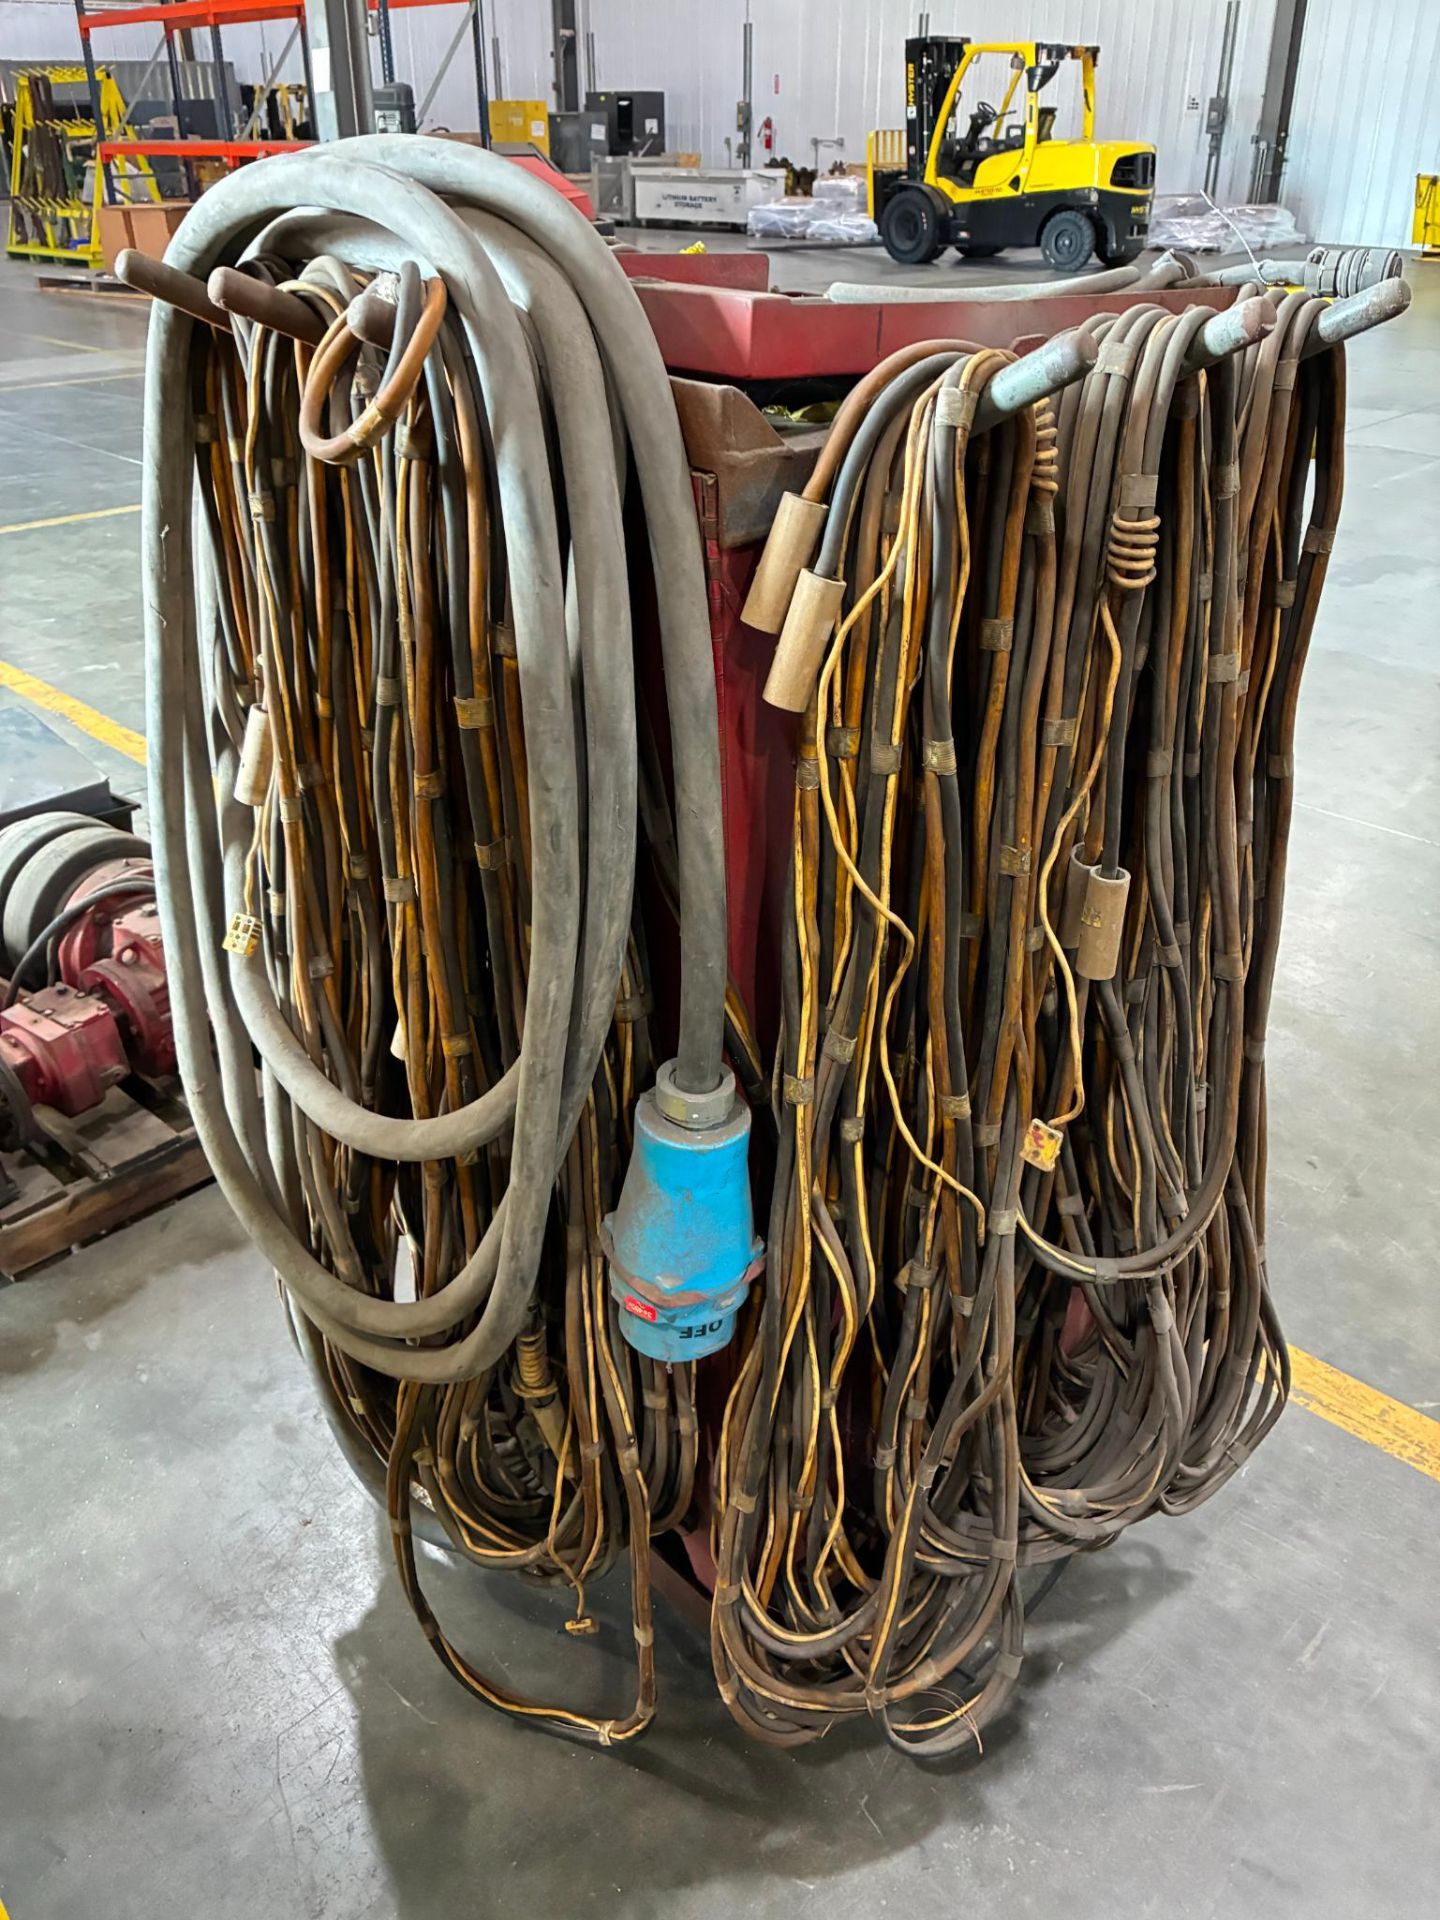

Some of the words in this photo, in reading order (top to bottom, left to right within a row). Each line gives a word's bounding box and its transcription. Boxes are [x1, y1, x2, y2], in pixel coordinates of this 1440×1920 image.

[907, 63, 915, 107] HYSTER
[674, 201, 702, 209] STORAGE
[679, 1319, 723, 1339] OFF
